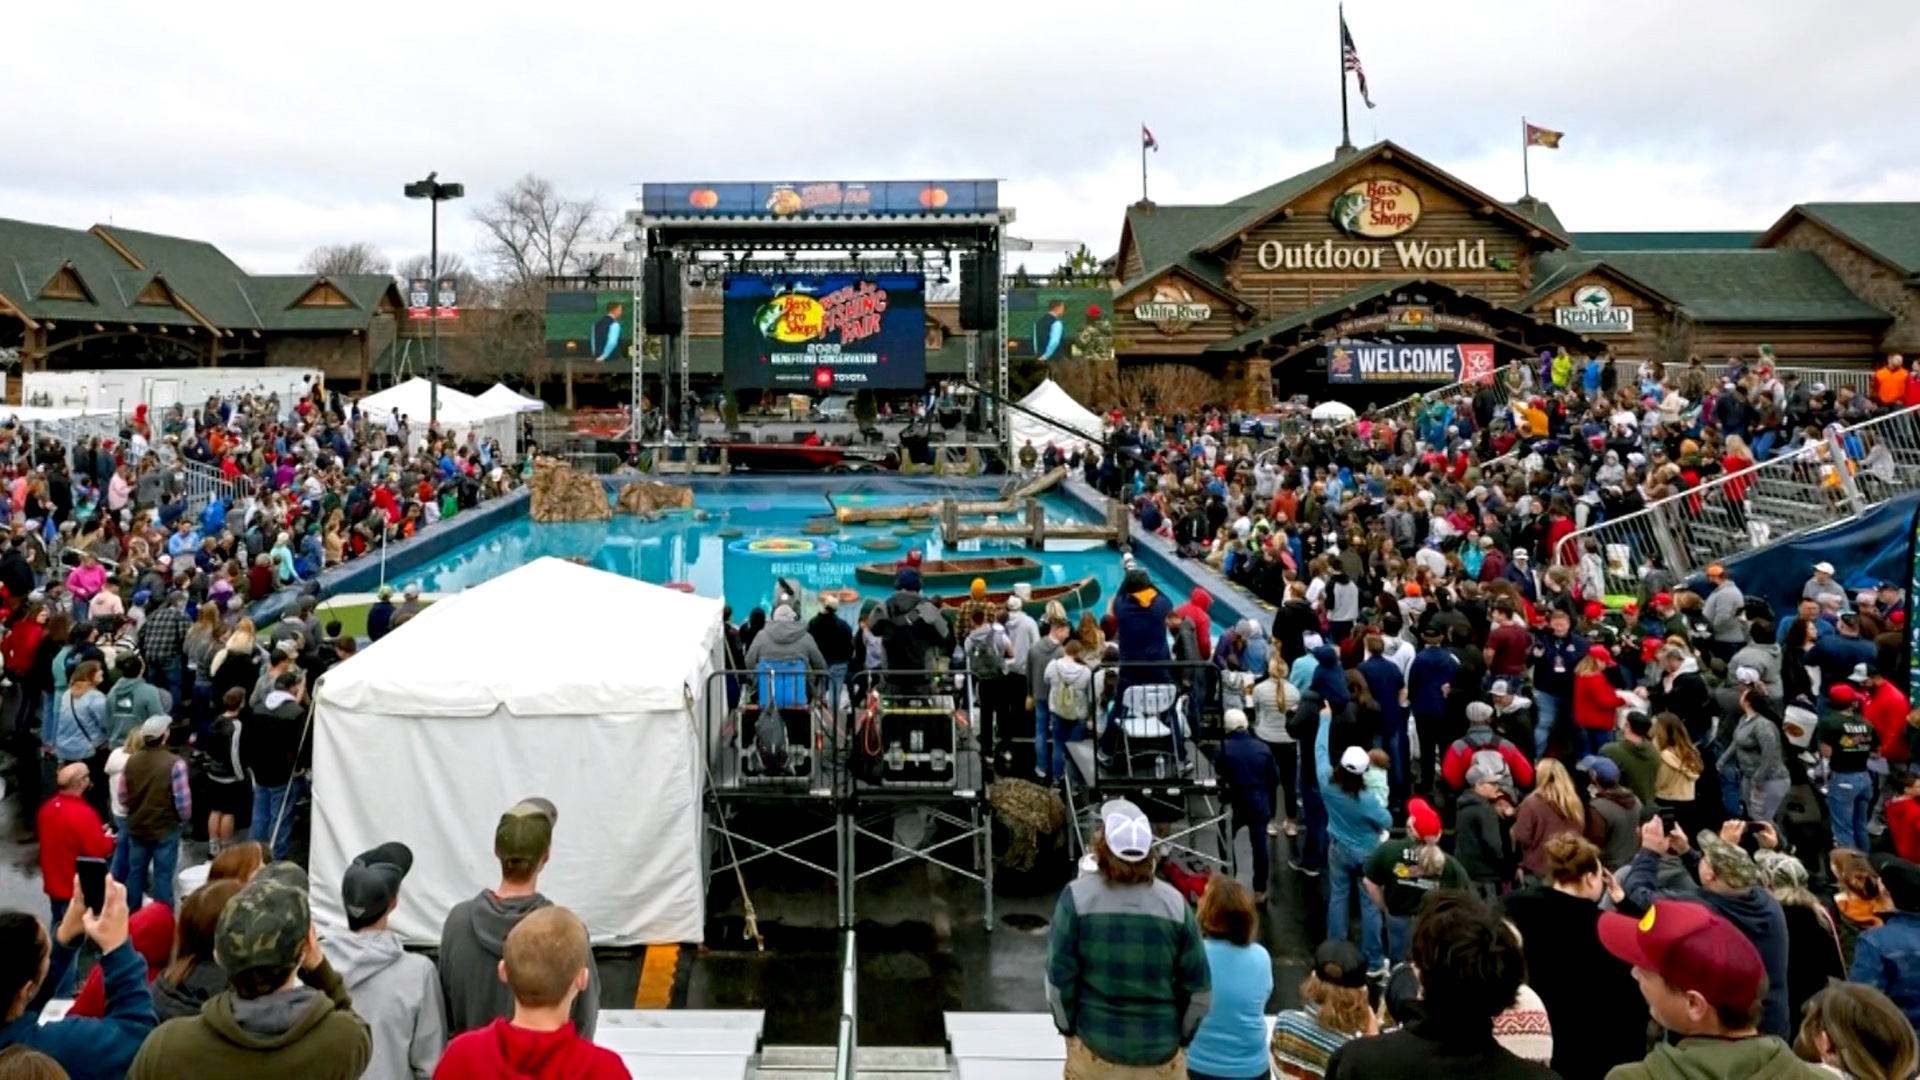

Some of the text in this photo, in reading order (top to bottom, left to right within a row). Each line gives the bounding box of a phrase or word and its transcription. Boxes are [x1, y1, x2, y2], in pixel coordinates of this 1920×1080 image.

[1367, 180, 1402, 197] Bass
[1370, 198, 1396, 213] Pro
[1369, 212, 1413, 229] Shops
[1258, 239, 1486, 270] Outdoor World
[785, 296, 812, 310] Bass
[1140, 304, 1208, 317] White River
[841, 313, 880, 345] FAIR
[818, 354, 878, 363] CONSERVATION
[1357, 348, 1455, 372] WELCOME
